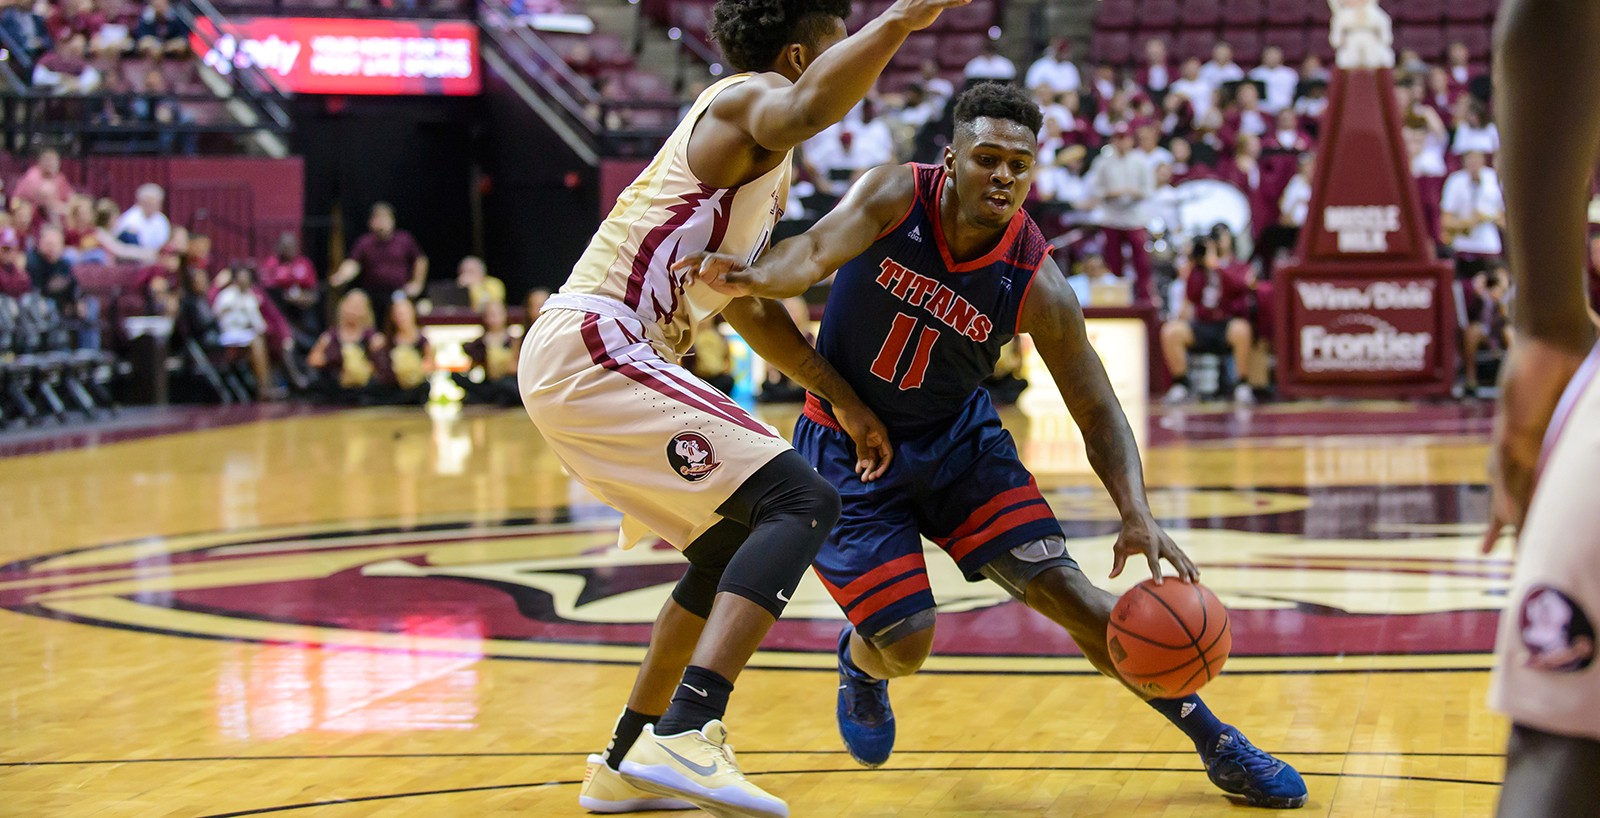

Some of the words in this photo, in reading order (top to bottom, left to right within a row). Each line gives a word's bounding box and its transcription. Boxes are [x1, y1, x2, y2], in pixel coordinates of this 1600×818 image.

[1324, 206, 1401, 232] MUSCLE
[1337, 231, 1388, 253] MILK
[875, 256, 994, 343] TITANS
[870, 312, 941, 391] 11
[1301, 325, 1432, 360] Frontier
